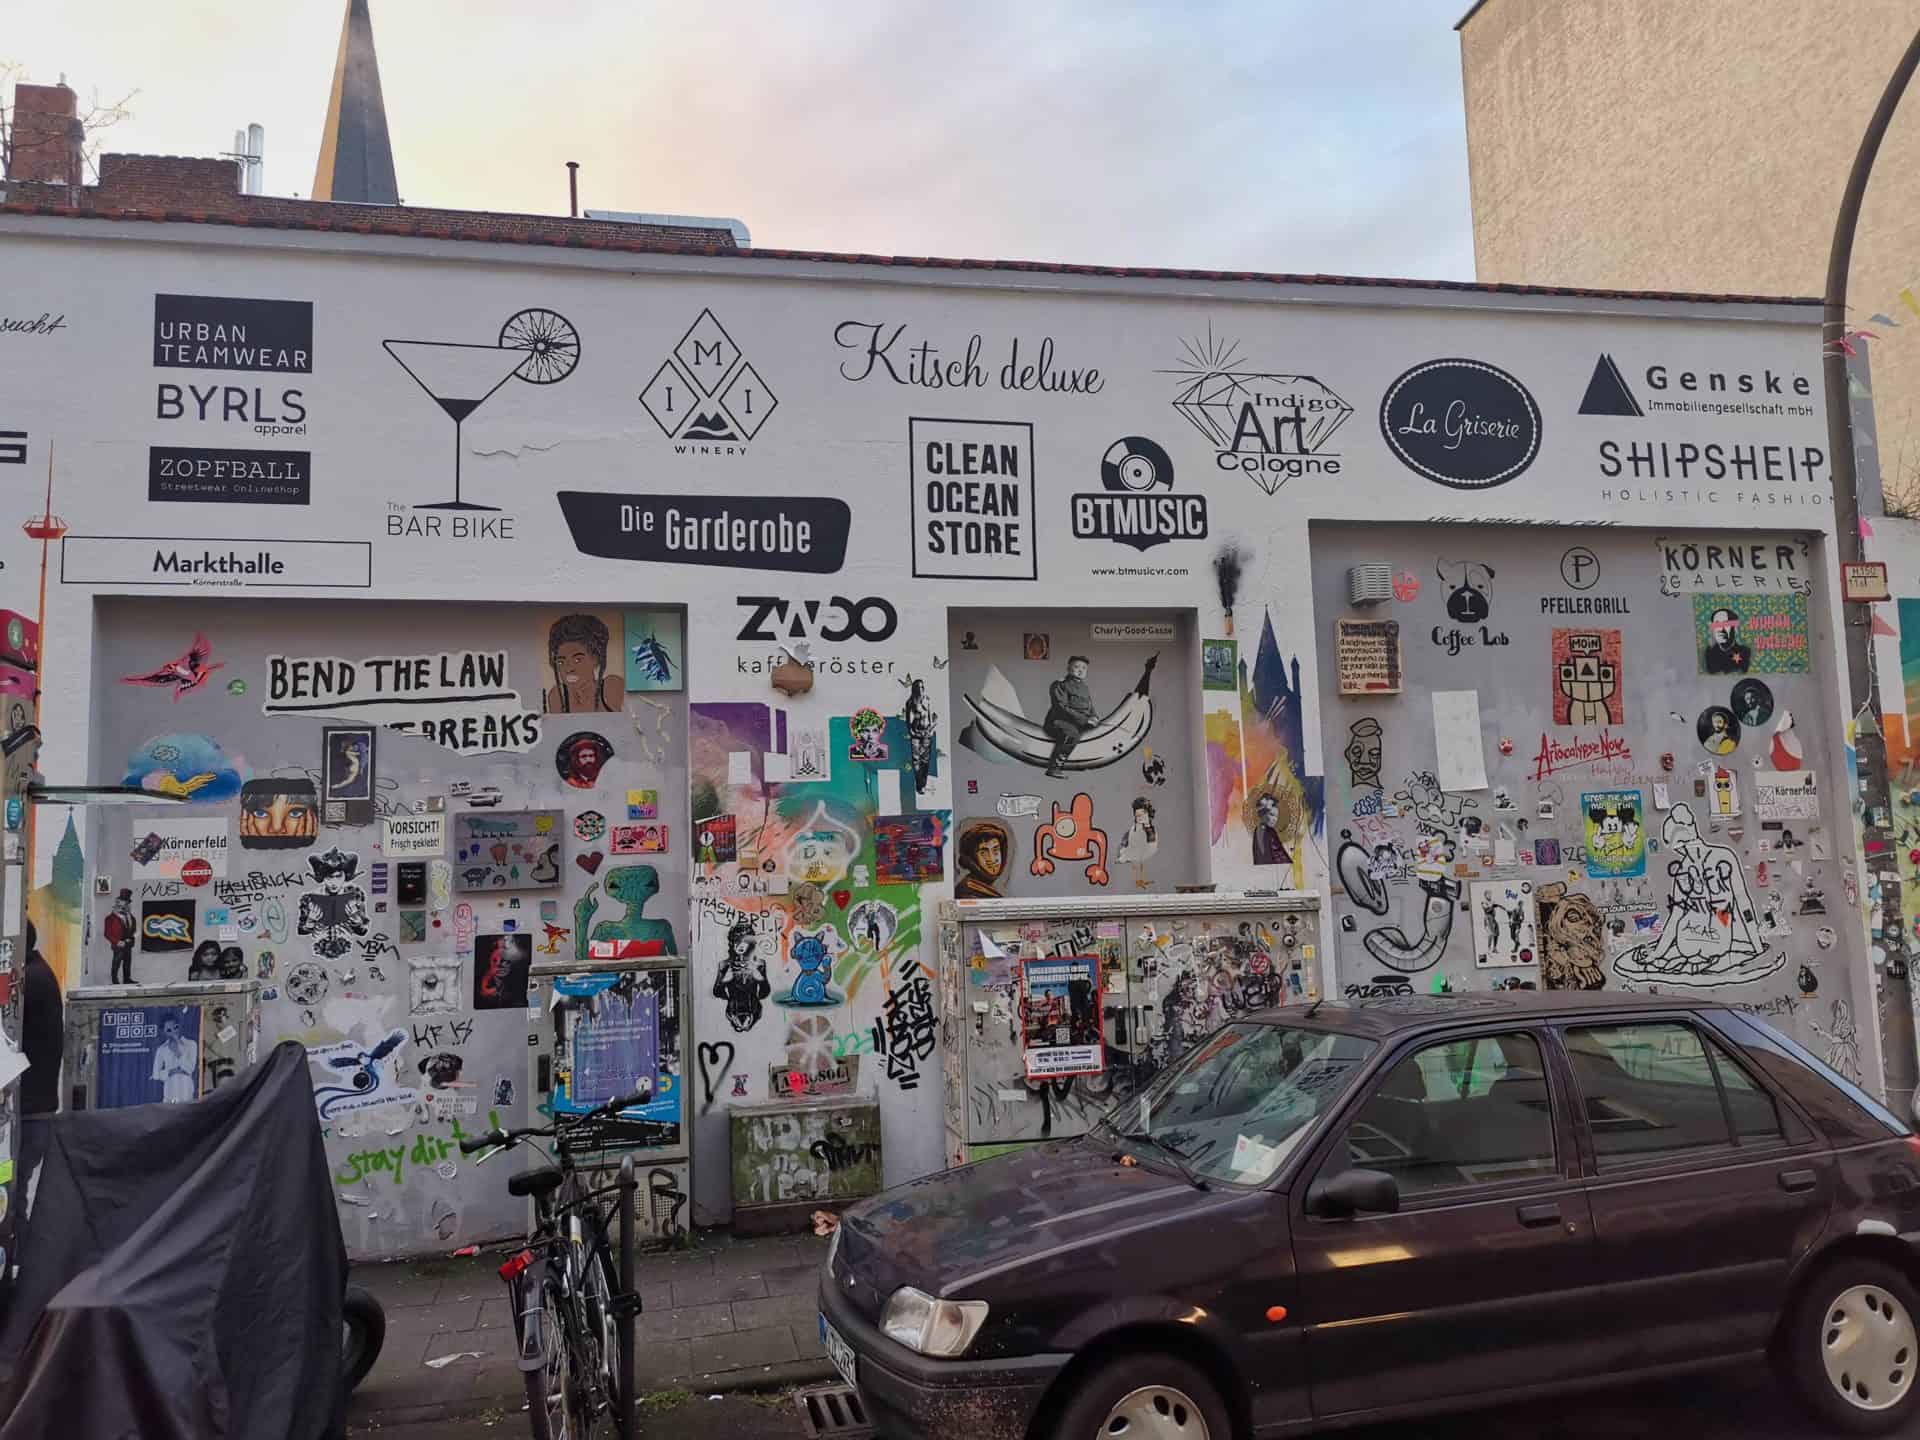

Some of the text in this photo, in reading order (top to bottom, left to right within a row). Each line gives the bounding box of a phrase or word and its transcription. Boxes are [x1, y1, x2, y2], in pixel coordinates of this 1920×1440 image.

[160, 321, 246, 343] URBAN
[160, 344, 306, 369] TEAMWEAR
[834, 321, 1105, 393] Kitsch deluxe
[1645, 366, 1811, 396] Genske
[157, 383, 306, 424] BYRLS
[1254, 393, 1340, 412] Indigo
[1648, 400, 1813, 416] Immobiliengesellschaft mbH
[254, 424, 307, 437] apparel
[1231, 401, 1309, 455] Art
[1399, 399, 1522, 450] La Griserie
[674, 445, 747, 455] WINERY
[926, 441, 1018, 477] CLEAN
[160, 459, 301, 480] ZOPFBALL
[1216, 453, 1341, 478] Cologne
[160, 482, 300, 496] Streetwear Onlineshop
[927, 481, 1019, 517] OCEAN
[1602, 489, 1721, 503] HOLISTIC
[386, 501, 407, 513] The
[1076, 497, 1204, 536] BTMUSIC
[387, 514, 514, 539] BAR BIKE
[620, 504, 811, 553] Die Garderobe
[927, 521, 1021, 556] STORE
[153, 550, 284, 574] Markthalle
[1665, 543, 1795, 571] KÖRNER
[1091, 567, 1189, 576] www.btmusicvr.com
[1670, 575, 1802, 590] GALERIE
[1541, 598, 1631, 614] PFEILER GRILL
[1431, 625, 1476, 656] Coffee
[270, 653, 504, 700] BEND THE LAW
[1775, 784, 1817, 796] Körnerfeld
[389, 821, 440, 834] VORSICHT!
[162, 835, 227, 850] Körnerfeld
[391, 839, 440, 850] Frisch geklebt!
[105, 1013, 143, 1024] THE
[117, 1026, 157, 1038] BOX
[335, 1145, 405, 1184] stay
